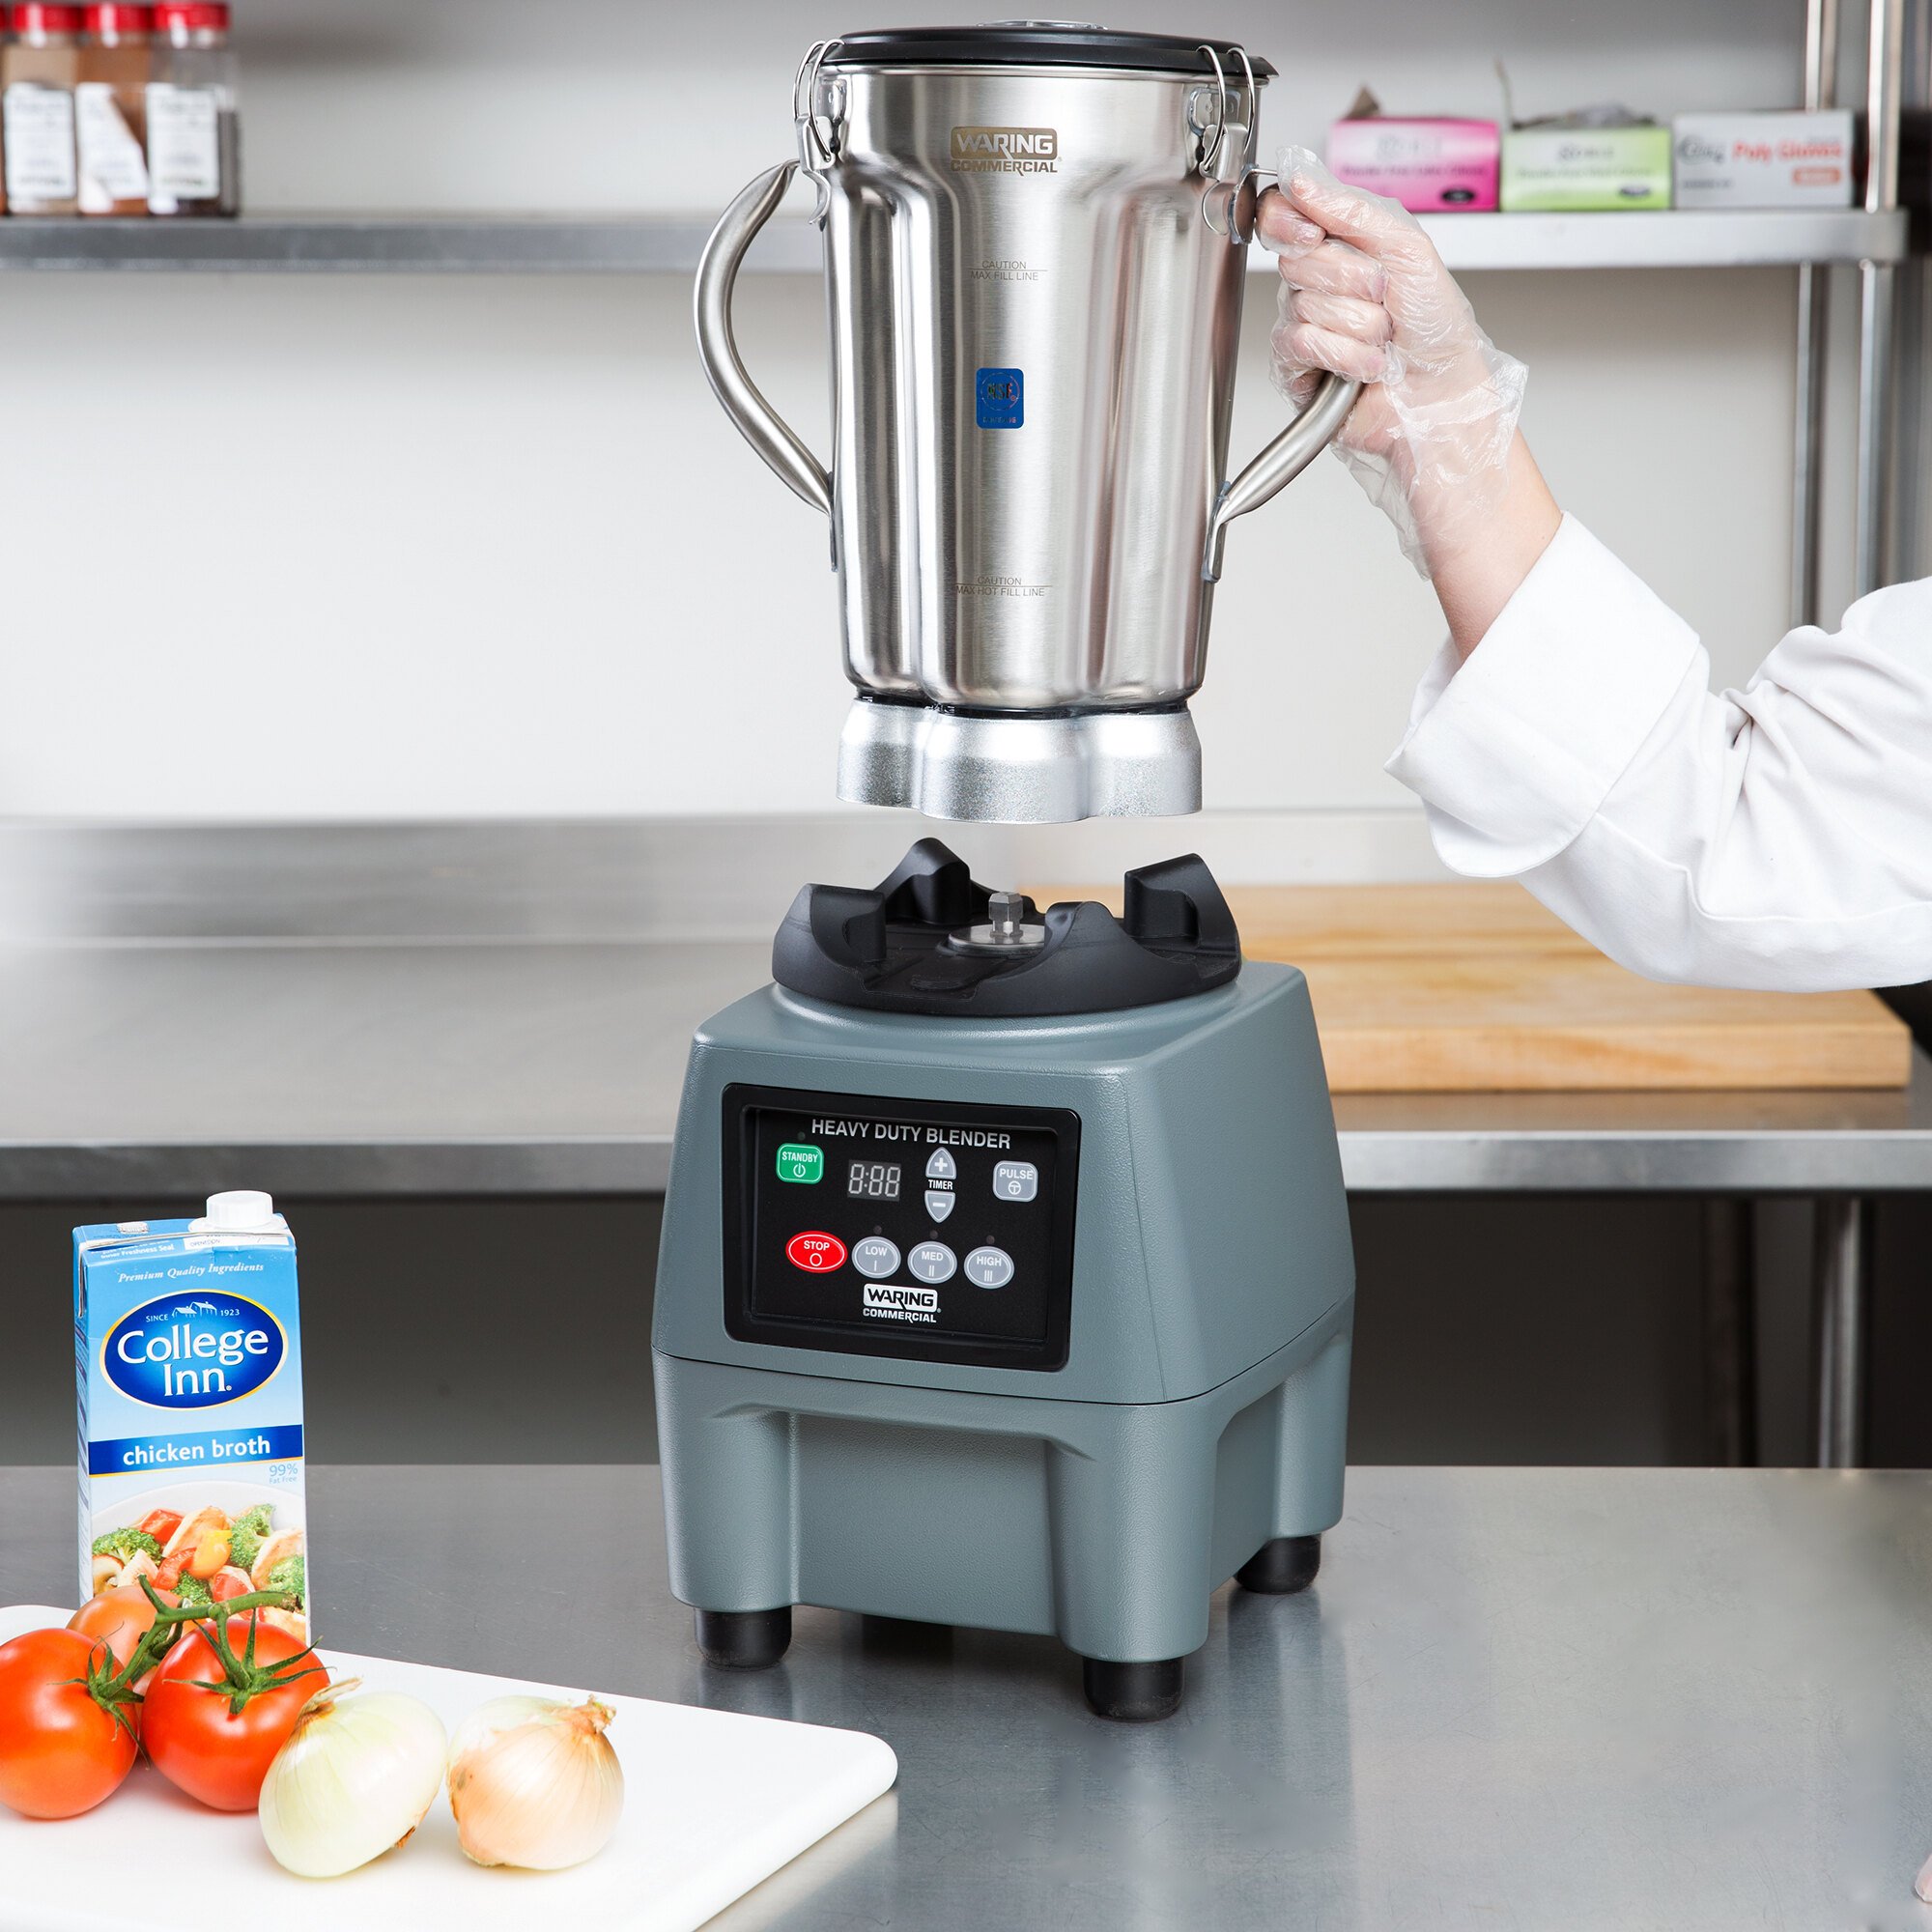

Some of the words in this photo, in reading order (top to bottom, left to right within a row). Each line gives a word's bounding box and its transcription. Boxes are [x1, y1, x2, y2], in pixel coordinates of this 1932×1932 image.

[957, 133, 1053, 159] WARING
[951, 159, 1058, 176] COMMERCIAL
[971, 270, 991, 279] MAX
[994, 271, 1014, 280] FILL
[978, 576, 1022, 585] CAUTION
[956, 585, 975, 594] MAX
[1001, 587, 1020, 596] FILL
[811, 1119, 869, 1138] HEAVY
[874, 1123, 922, 1142] DUTY
[926, 1128, 1010, 1150] BLENDER
[781, 1151, 818, 1163] STANDBY
[999, 1168, 1034, 1179] PULSE
[928, 1179, 953, 1190] TIMER
[804, 1239, 830, 1251] STOP
[866, 1246, 887, 1256] LOW
[922, 1251, 943, 1262] MED
[977, 1256, 1002, 1266] HIGH
[118, 1271, 163, 1283] Premium
[167, 1265, 206, 1278] Quality
[208, 1262, 264, 1274] Ingredients
[867, 1289, 934, 1310] WARING
[146, 1314, 169, 1322] SINCE
[220, 1308, 241, 1317] 1923
[863, 1307, 937, 1323] COMMERCIAL
[117, 1323, 269, 1366] College
[123, 1443, 204, 1465] chicken
[212, 1435, 270, 1458] broth
[270, 1463, 298, 1476] 99%
